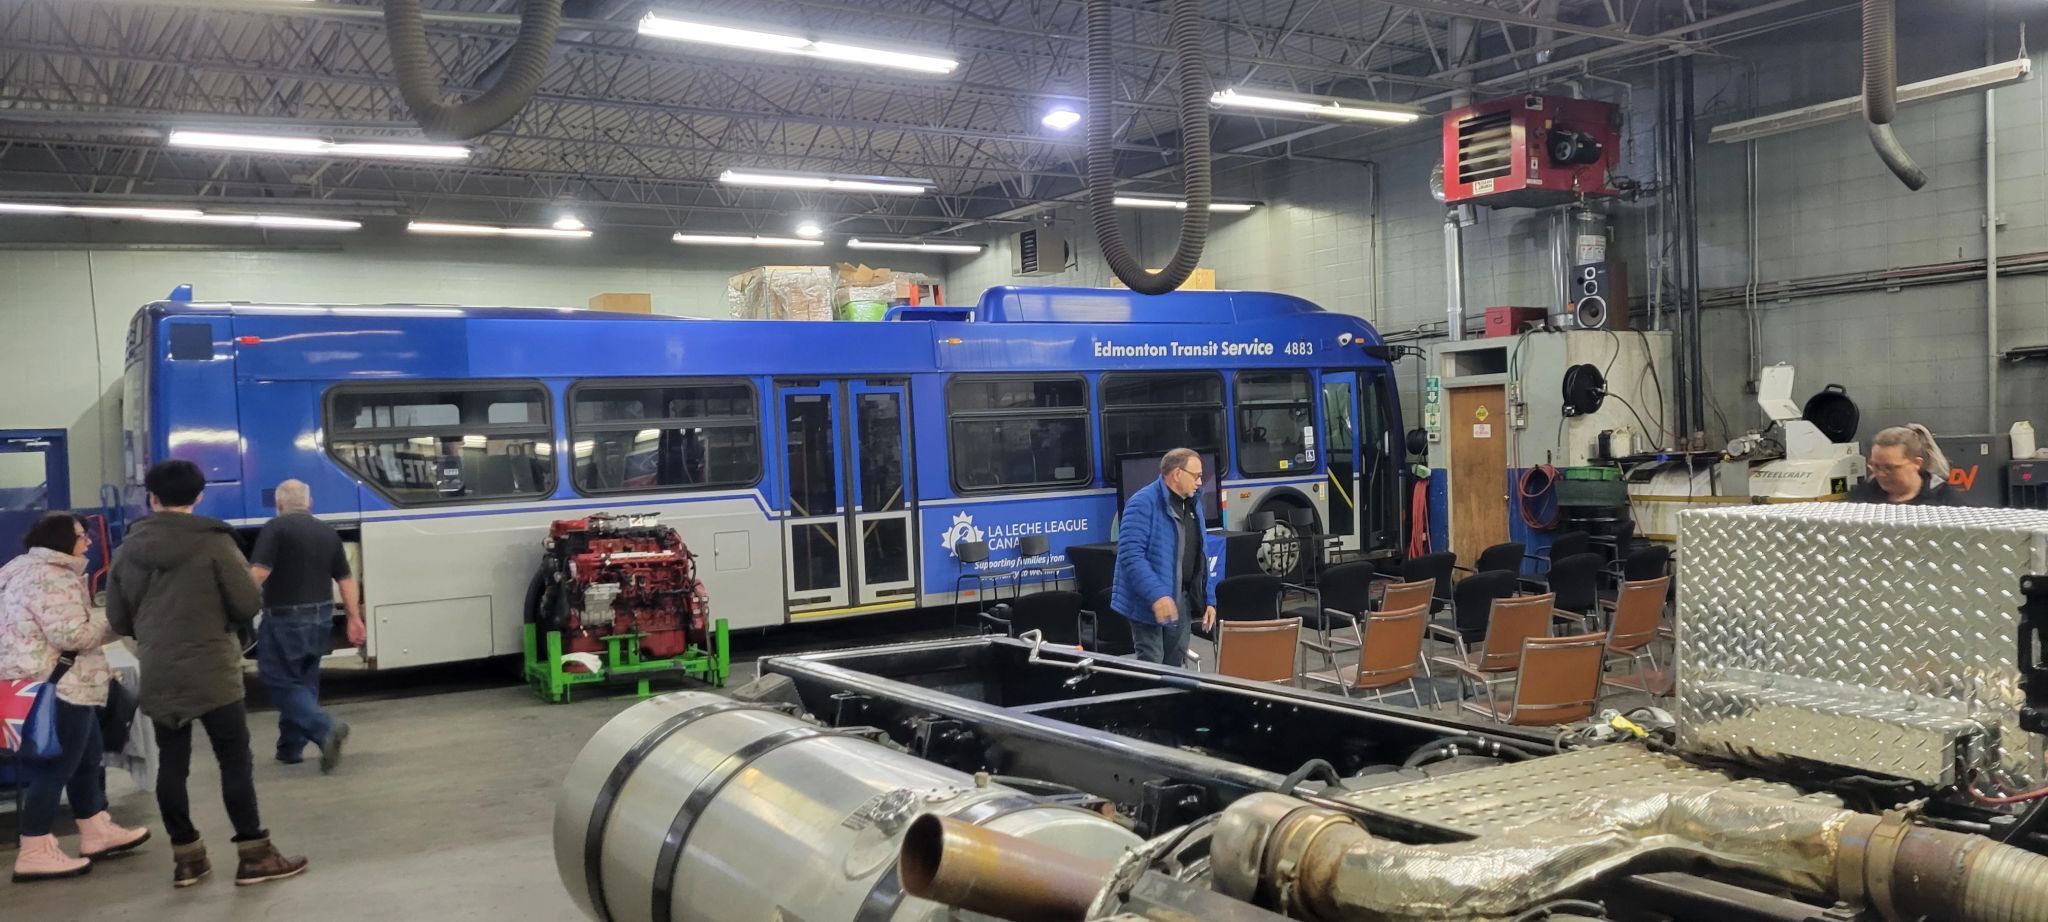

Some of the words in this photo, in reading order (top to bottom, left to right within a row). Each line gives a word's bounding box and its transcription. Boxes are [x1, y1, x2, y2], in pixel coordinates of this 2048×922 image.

[1094, 341, 1167, 356] Edmonton
[1171, 341, 1218, 356] Transit
[1221, 338, 1273, 356] Service
[1284, 341, 1313, 355] 4883
[1753, 470, 1813, 479] STEELCRAFT
[988, 525, 1002, 537] LA
[1005, 522, 1042, 536] LECHE
[1045, 519, 1088, 533] LEAGUE
[988, 537, 1020, 550] CANA
[974, 559, 1015, 570] Supporting
